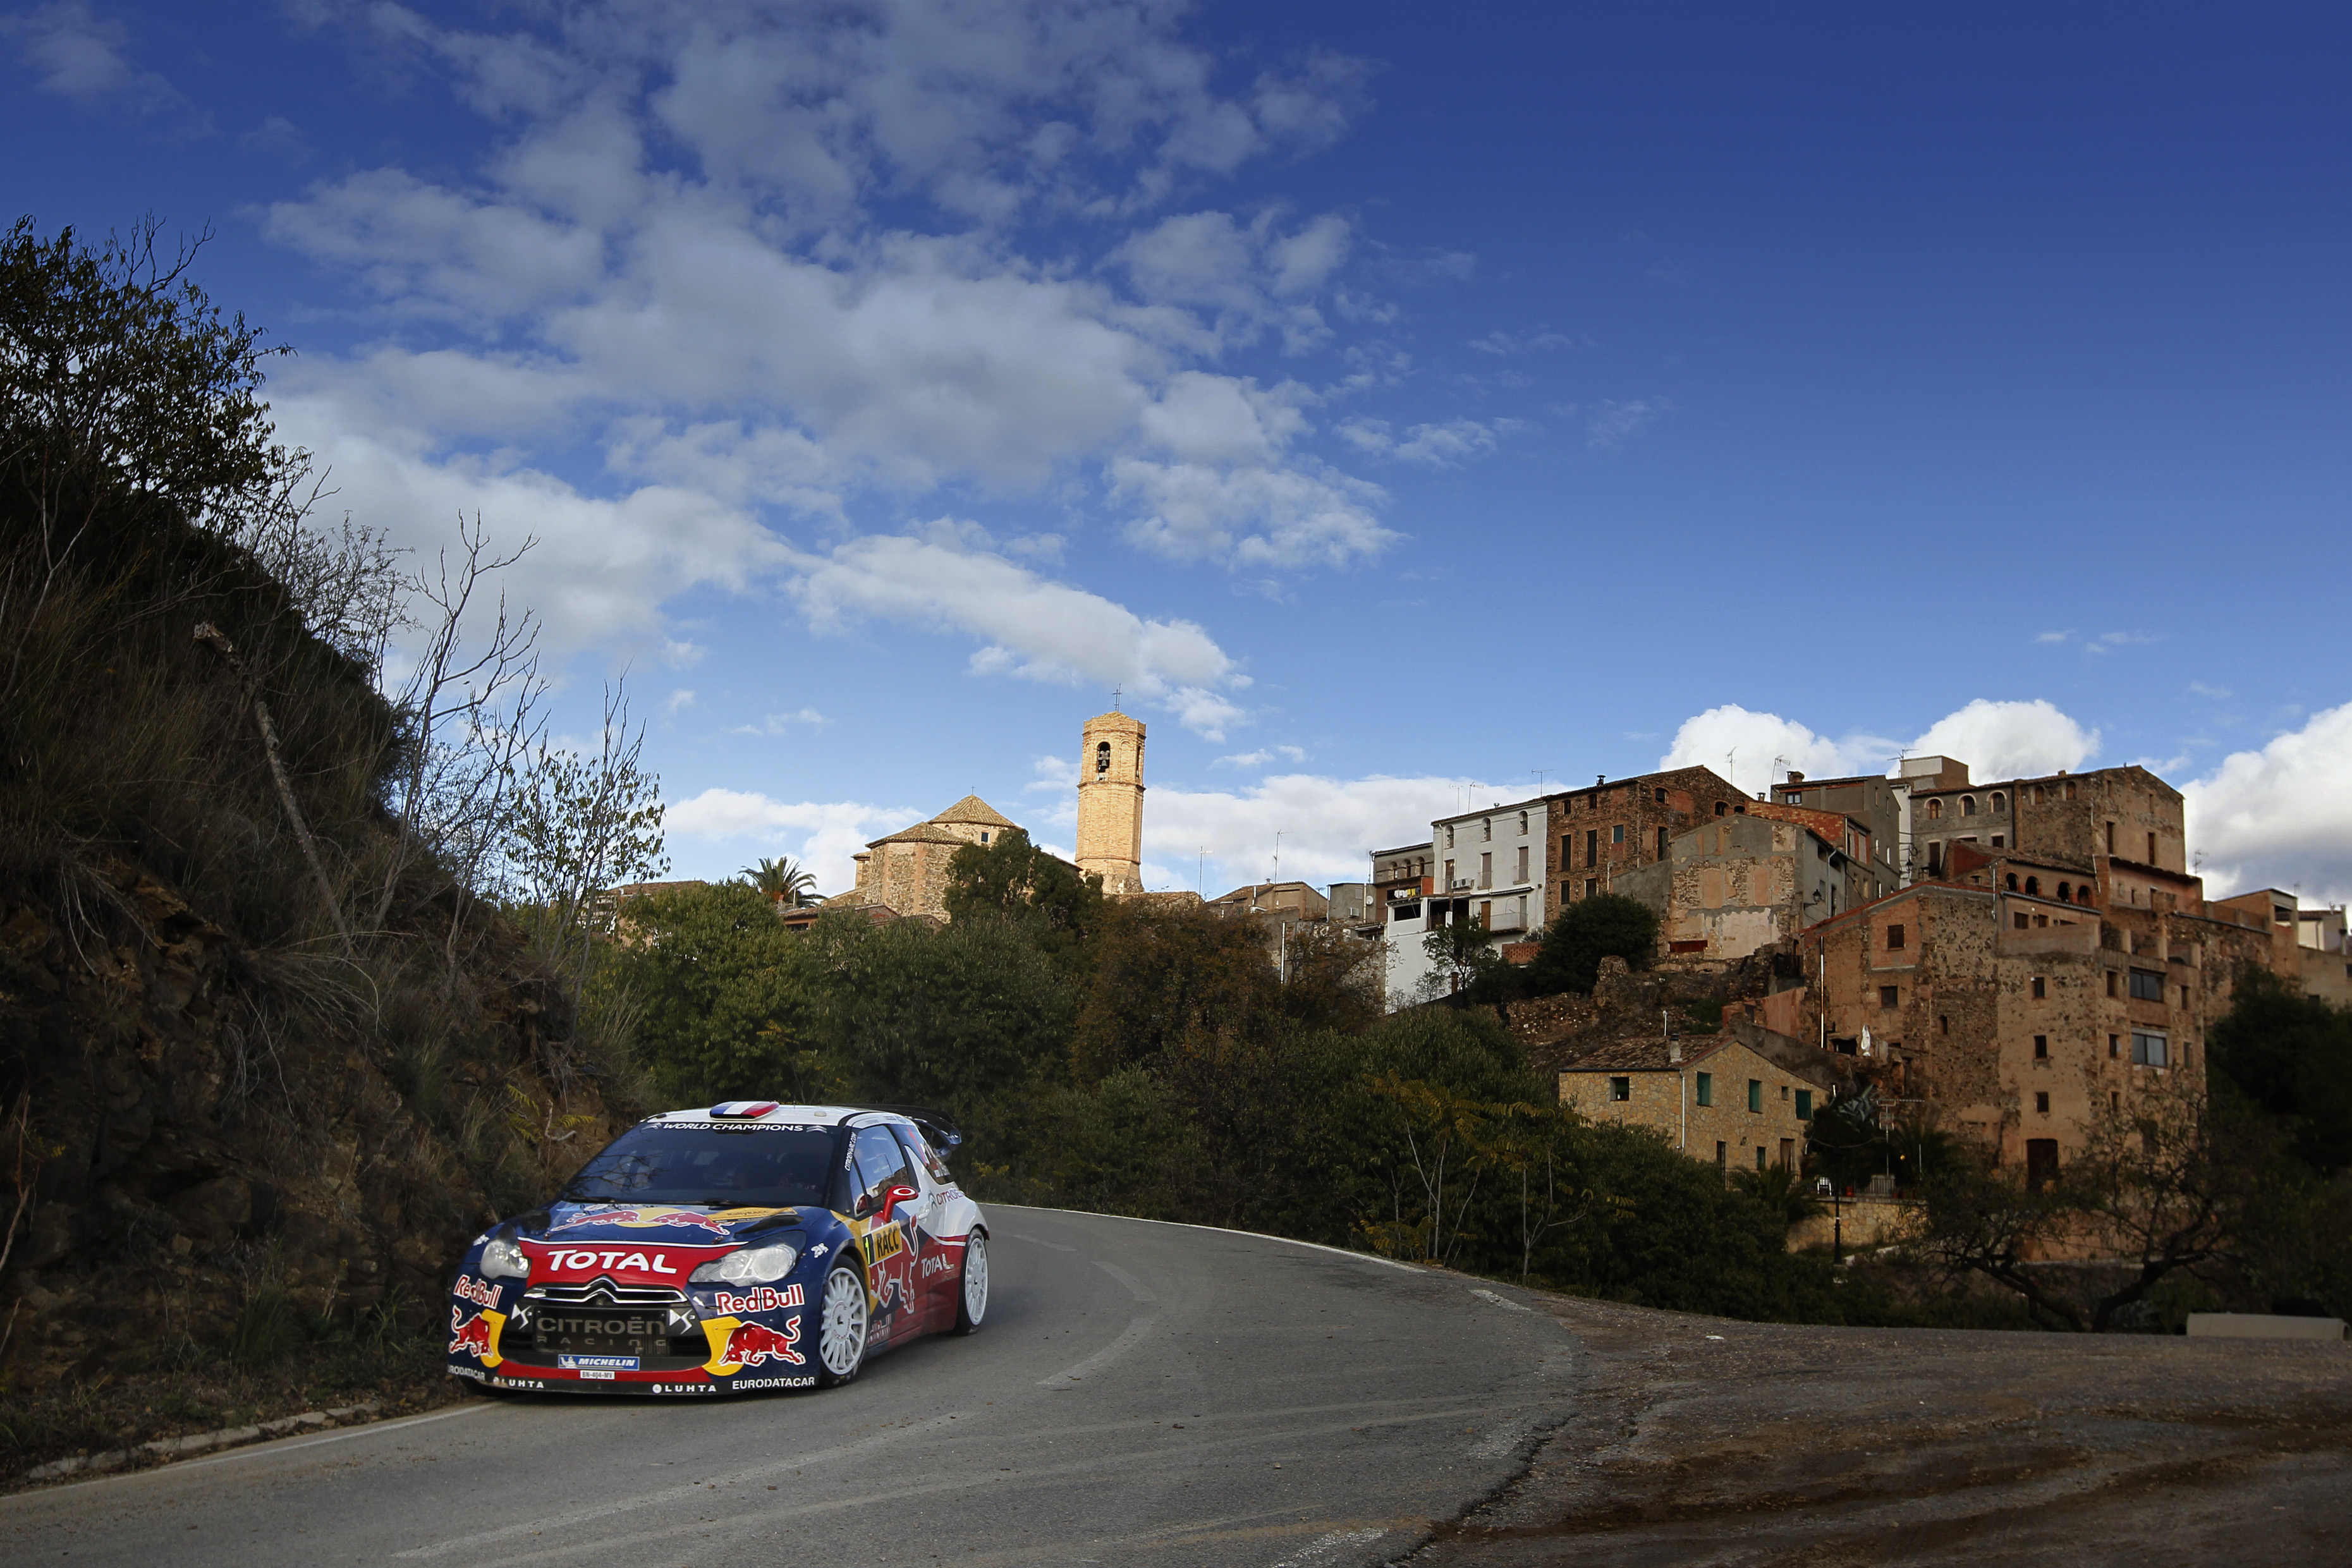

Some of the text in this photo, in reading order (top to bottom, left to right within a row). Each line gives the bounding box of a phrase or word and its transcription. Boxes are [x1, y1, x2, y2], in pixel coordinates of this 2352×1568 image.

[712, 1123, 803, 1131] CHAMPIONS
[876, 1225, 899, 1258] RACC
[547, 1249, 677, 1274] TOTAL
[921, 1253, 954, 1279] TOTAL
[537, 1336, 666, 1346] RACING
[578, 1358, 636, 1366] MICHELIN
[665, 1384, 717, 1392] LUHTA
[732, 1377, 815, 1390] EURODATACAR
